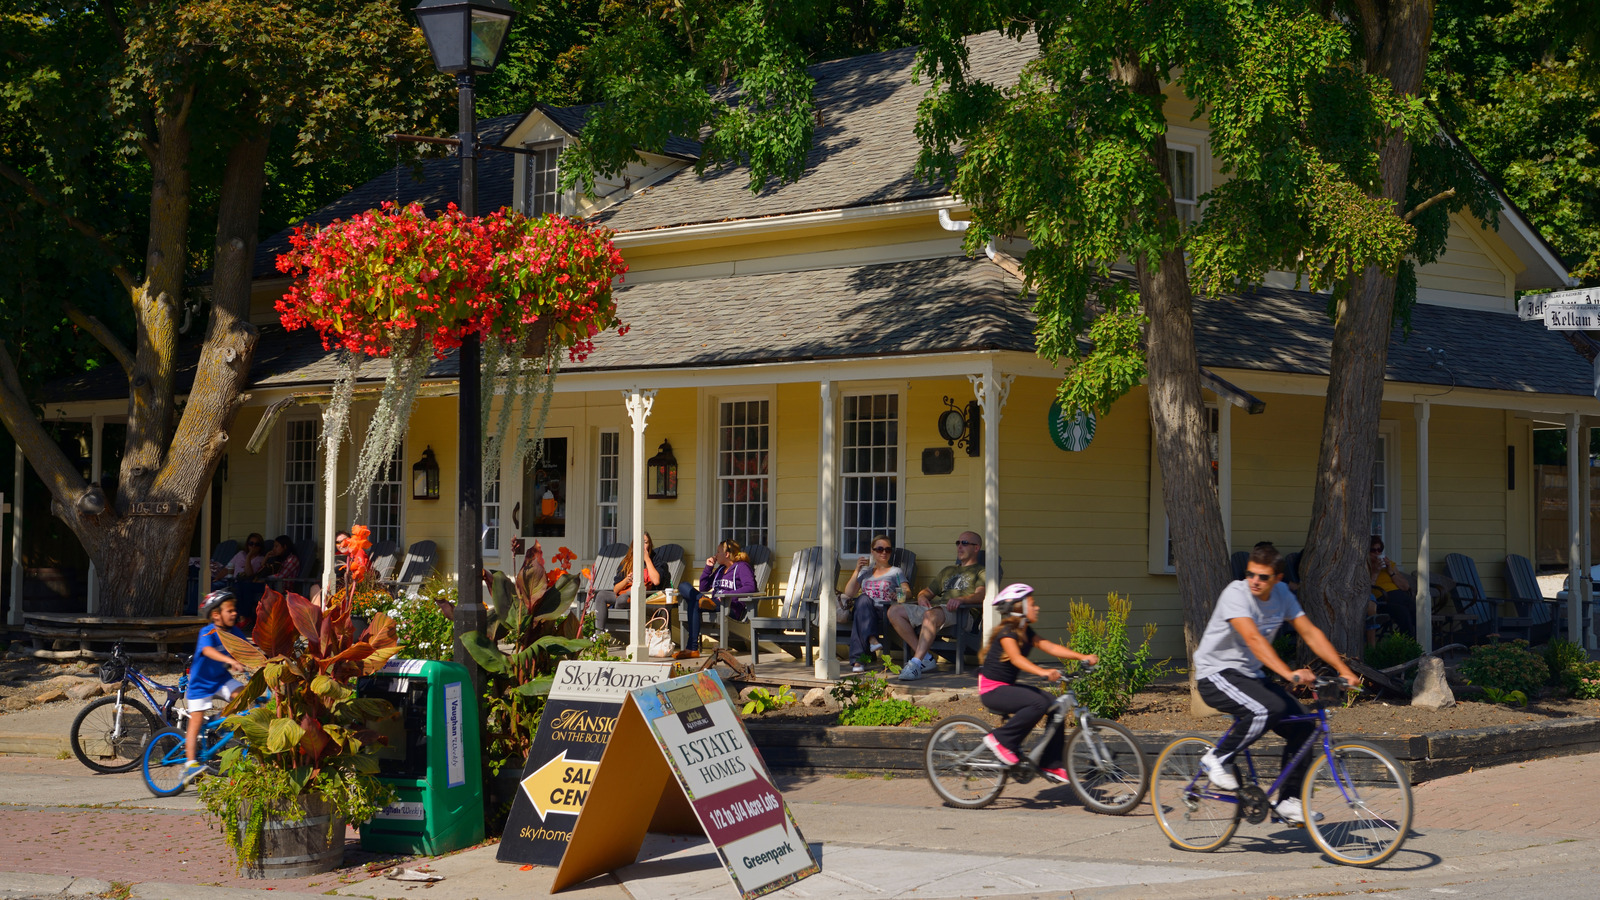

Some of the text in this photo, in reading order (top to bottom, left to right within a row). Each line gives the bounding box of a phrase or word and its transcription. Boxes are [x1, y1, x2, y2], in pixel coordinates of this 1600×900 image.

[1551, 311, 1591, 326] Kellam
[561, 665, 660, 691] SkyHomes
[450, 699, 458, 736] Vaughan
[551, 731, 611, 744] ON THE BOUL
[677, 729, 743, 766] ESTATE
[562, 767, 592, 785] SAL
[699, 756, 746, 784] HOMES
[549, 788, 588, 807] CEN
[709, 792, 780, 830] 1/2 to 3/4 Acre Lots
[520, 826, 573, 842] skyhome
[743, 841, 794, 869] Greenpark
